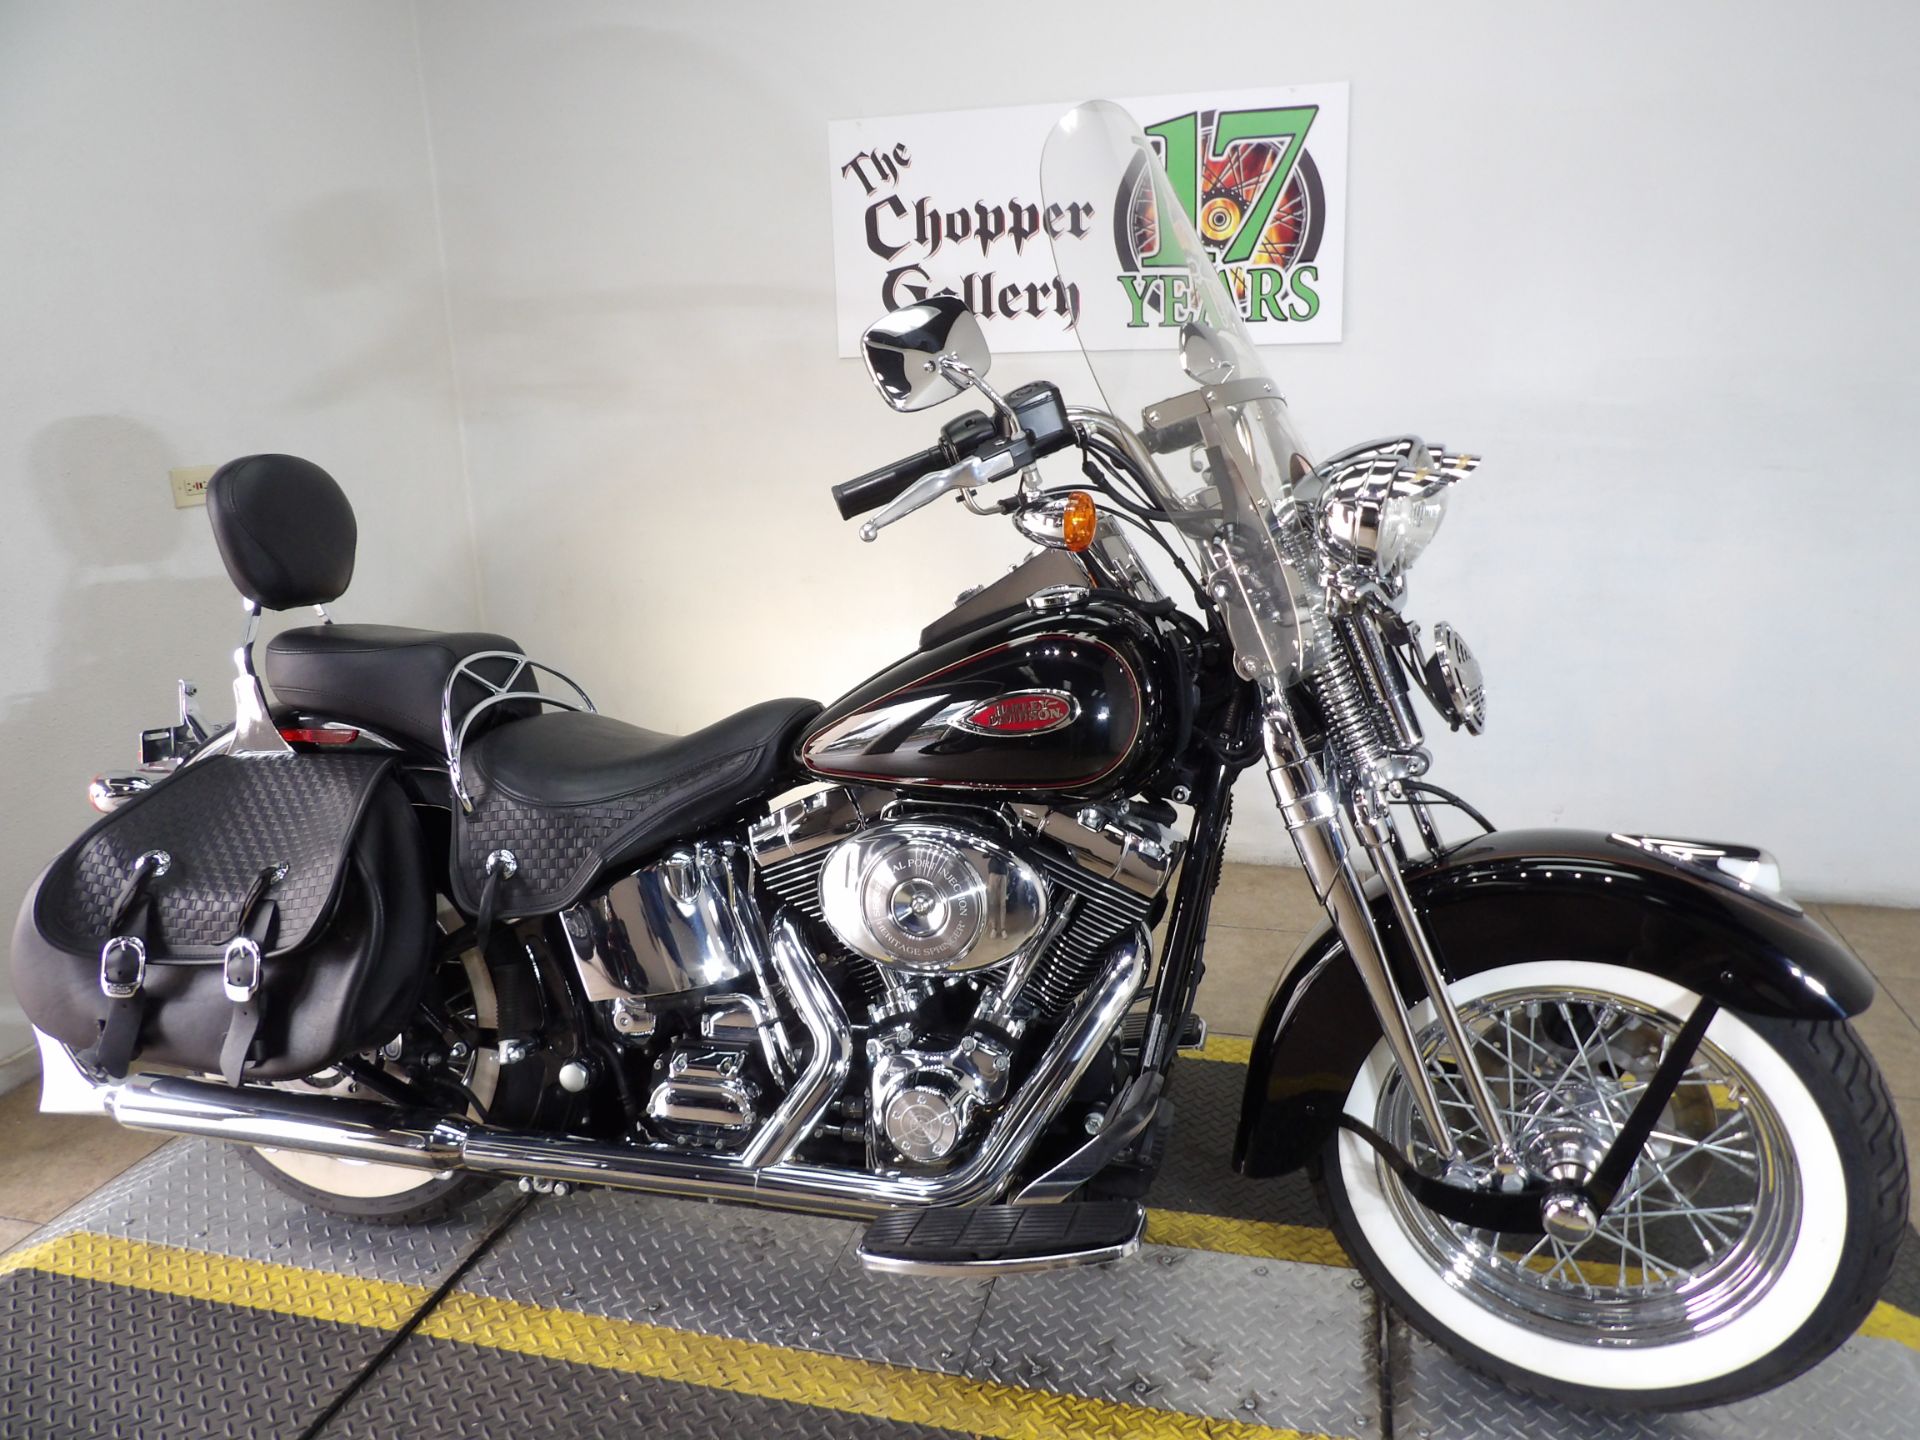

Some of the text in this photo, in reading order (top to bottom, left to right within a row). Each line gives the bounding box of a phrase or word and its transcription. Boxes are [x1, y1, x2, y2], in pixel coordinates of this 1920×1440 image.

[841, 142, 912, 196] The
[1142, 104, 1319, 268] 17
[865, 194, 1095, 262] Chopper
[882, 263, 1081, 331] Gllery
[938, 866, 968, 916] INJECION
[876, 921, 920, 956] HERITAGE
